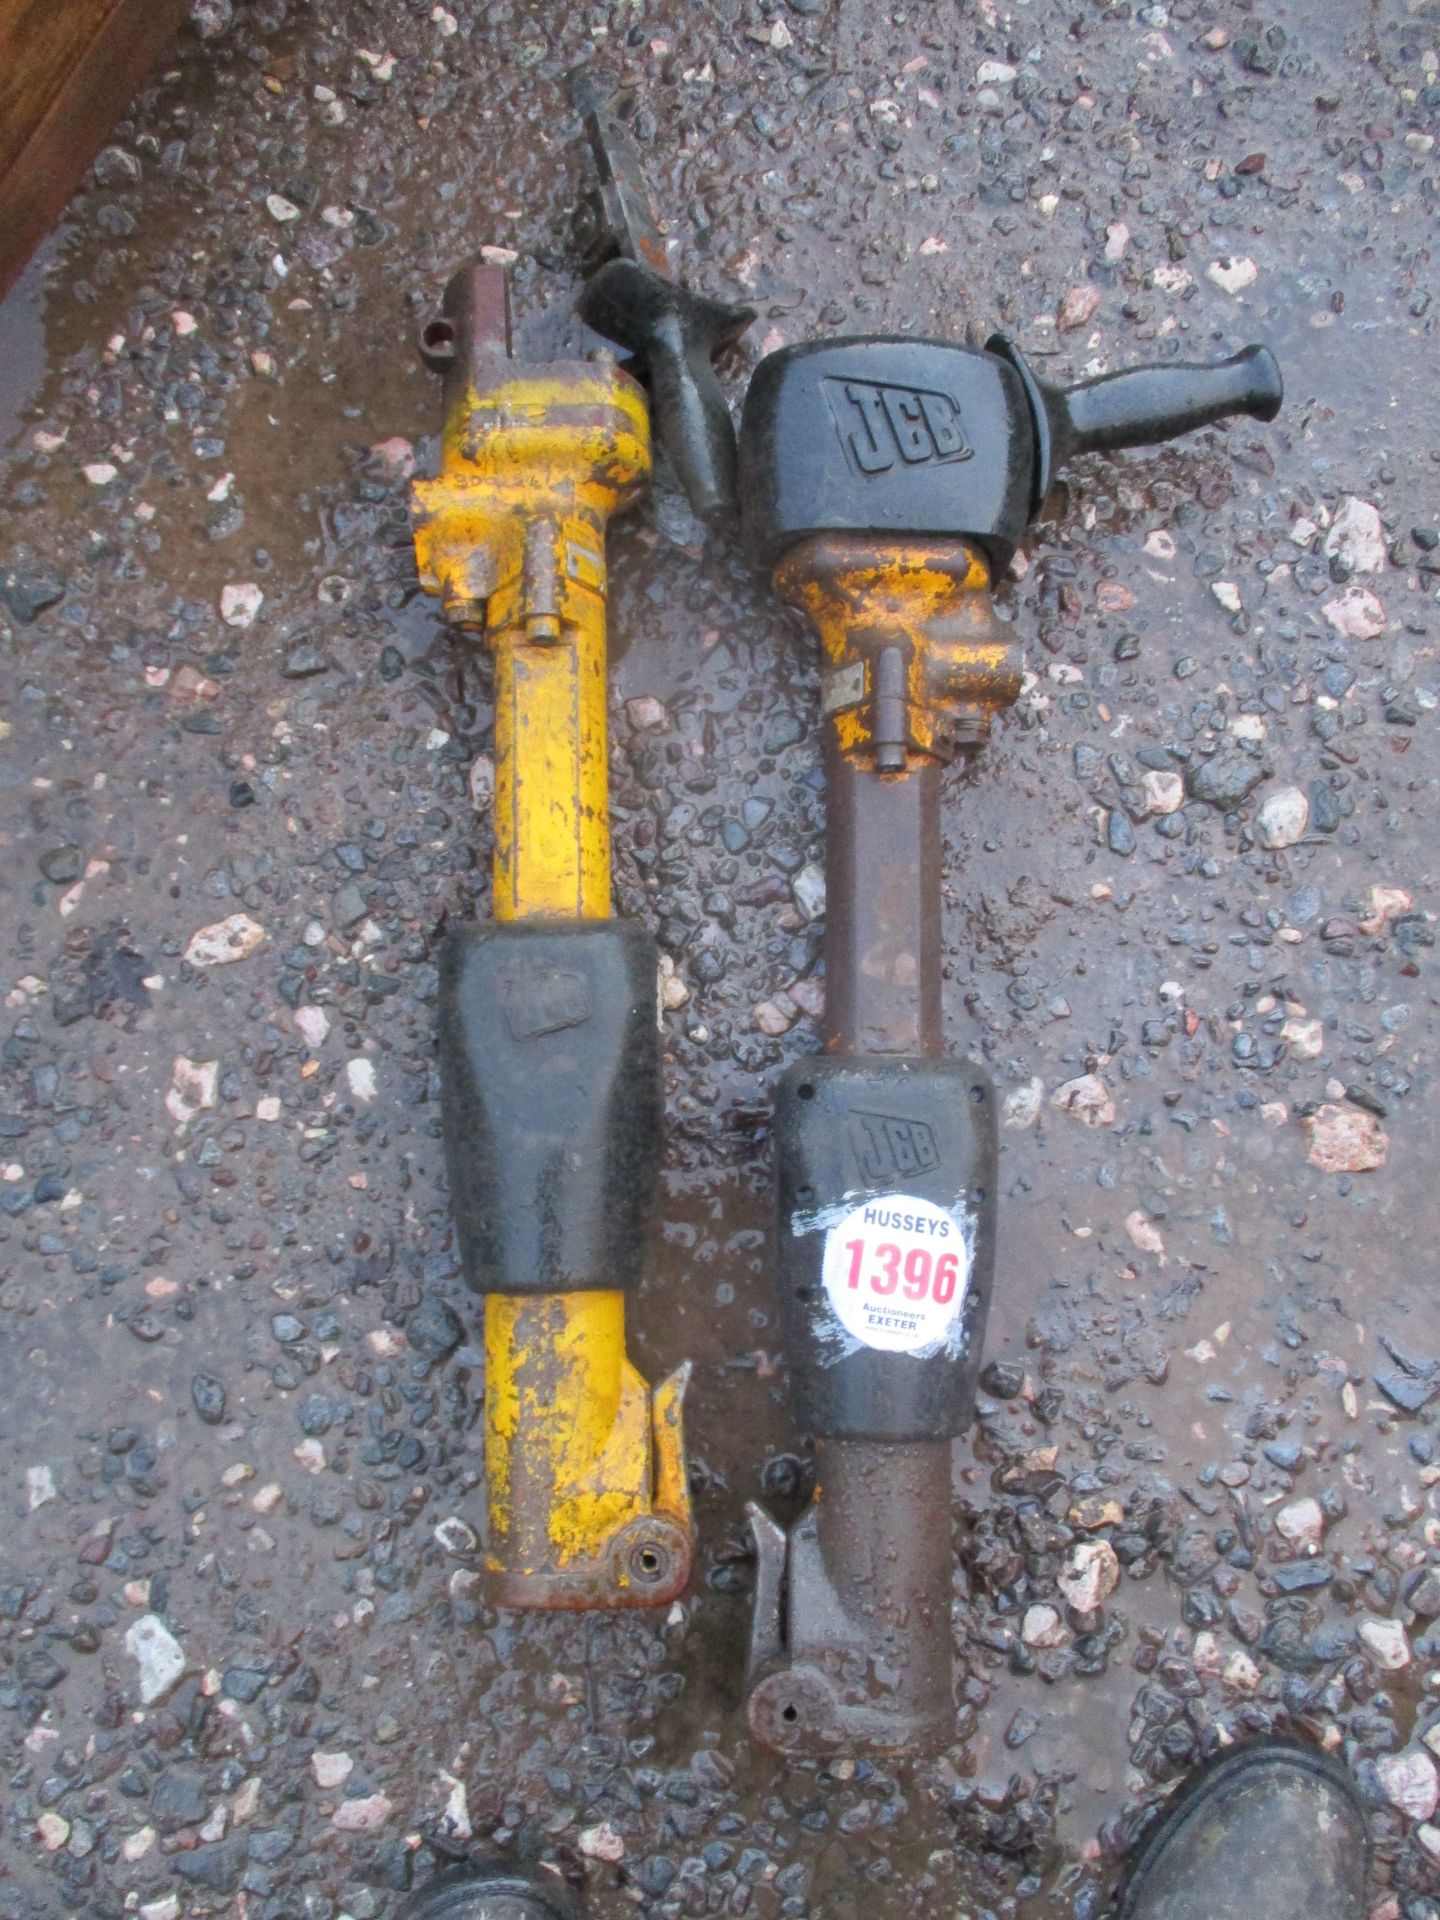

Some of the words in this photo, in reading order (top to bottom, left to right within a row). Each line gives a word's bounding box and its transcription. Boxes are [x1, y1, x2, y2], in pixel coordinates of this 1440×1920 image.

[844, 384, 965, 475] JCB
[860, 1118, 935, 1179] JCB
[863, 1208, 950, 1237] HUSSEYS
[846, 1239, 959, 1305] 1396
[863, 1303, 926, 1321] Auctioneers
[868, 1314, 917, 1330] EXETER
